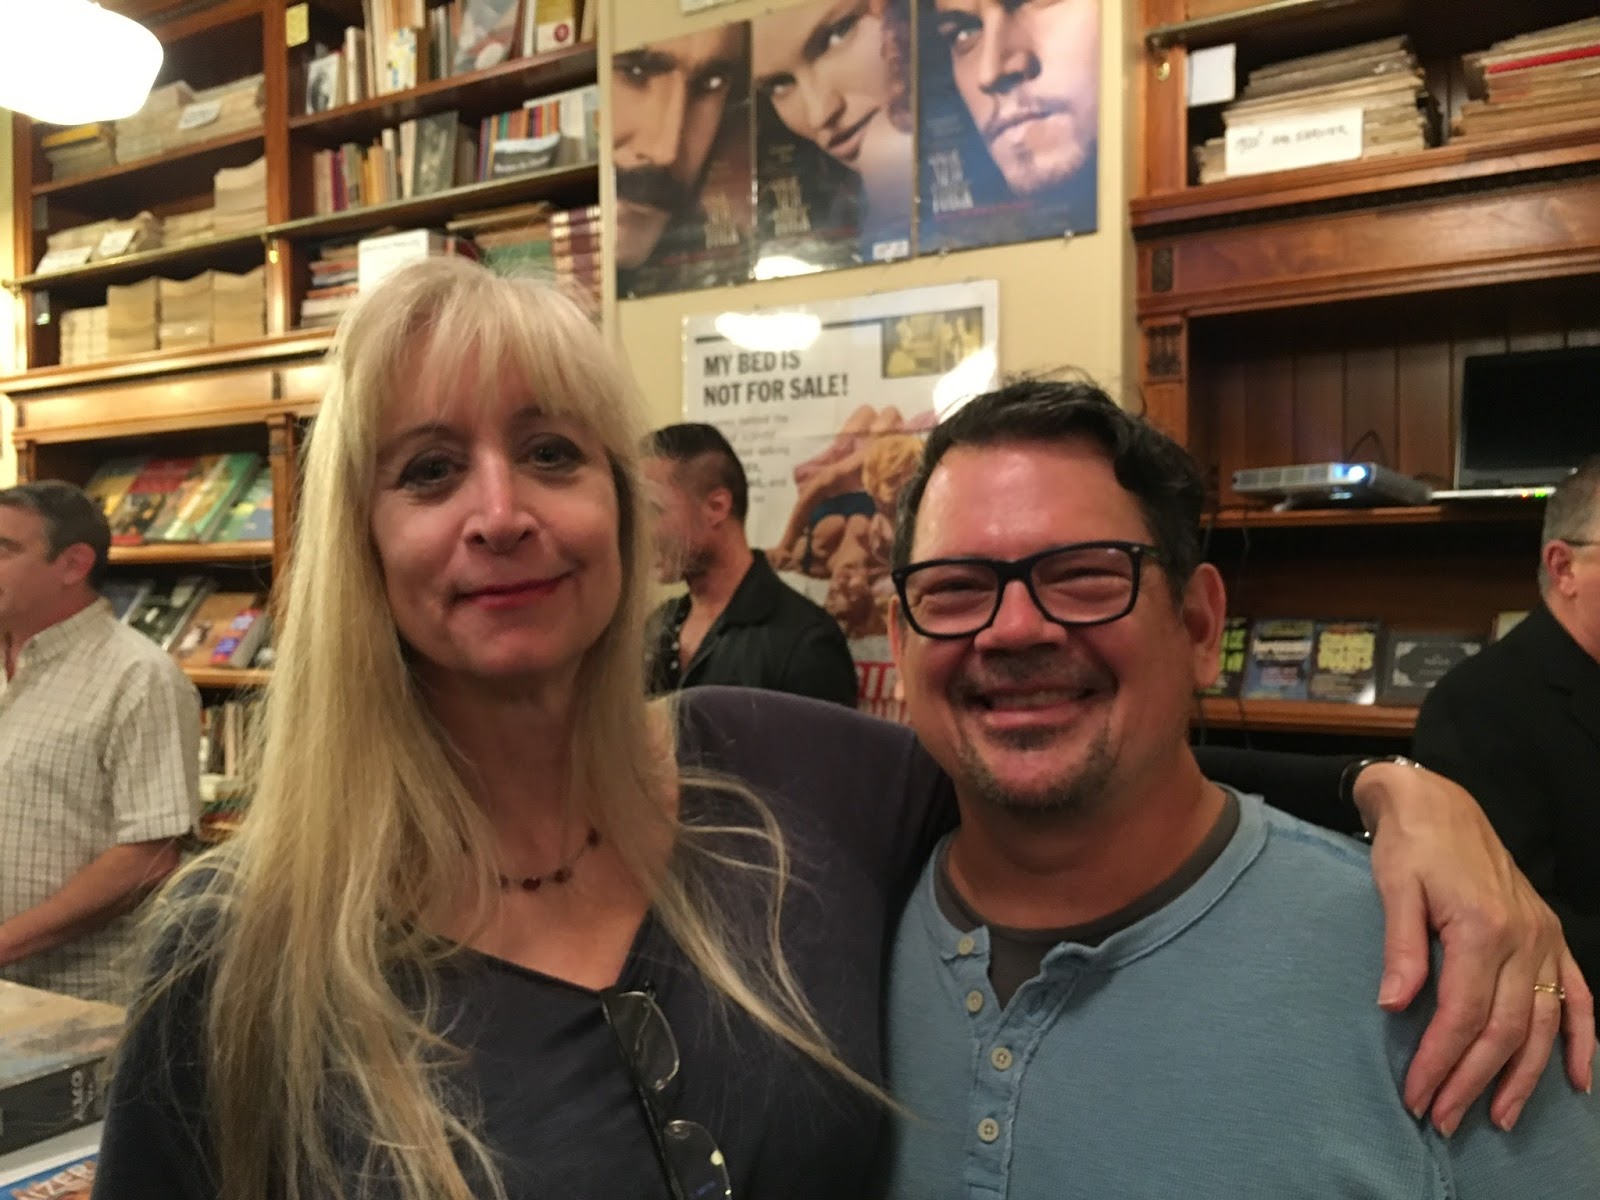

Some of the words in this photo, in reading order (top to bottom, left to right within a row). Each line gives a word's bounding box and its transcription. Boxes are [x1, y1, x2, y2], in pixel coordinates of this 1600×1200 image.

[704, 355, 732, 376] MY
[738, 351, 776, 374] BED
[782, 350, 801, 370] IS
[704, 383, 741, 406] NOT
[746, 379, 785, 403] FOR
[790, 373, 848, 400] SALE!
